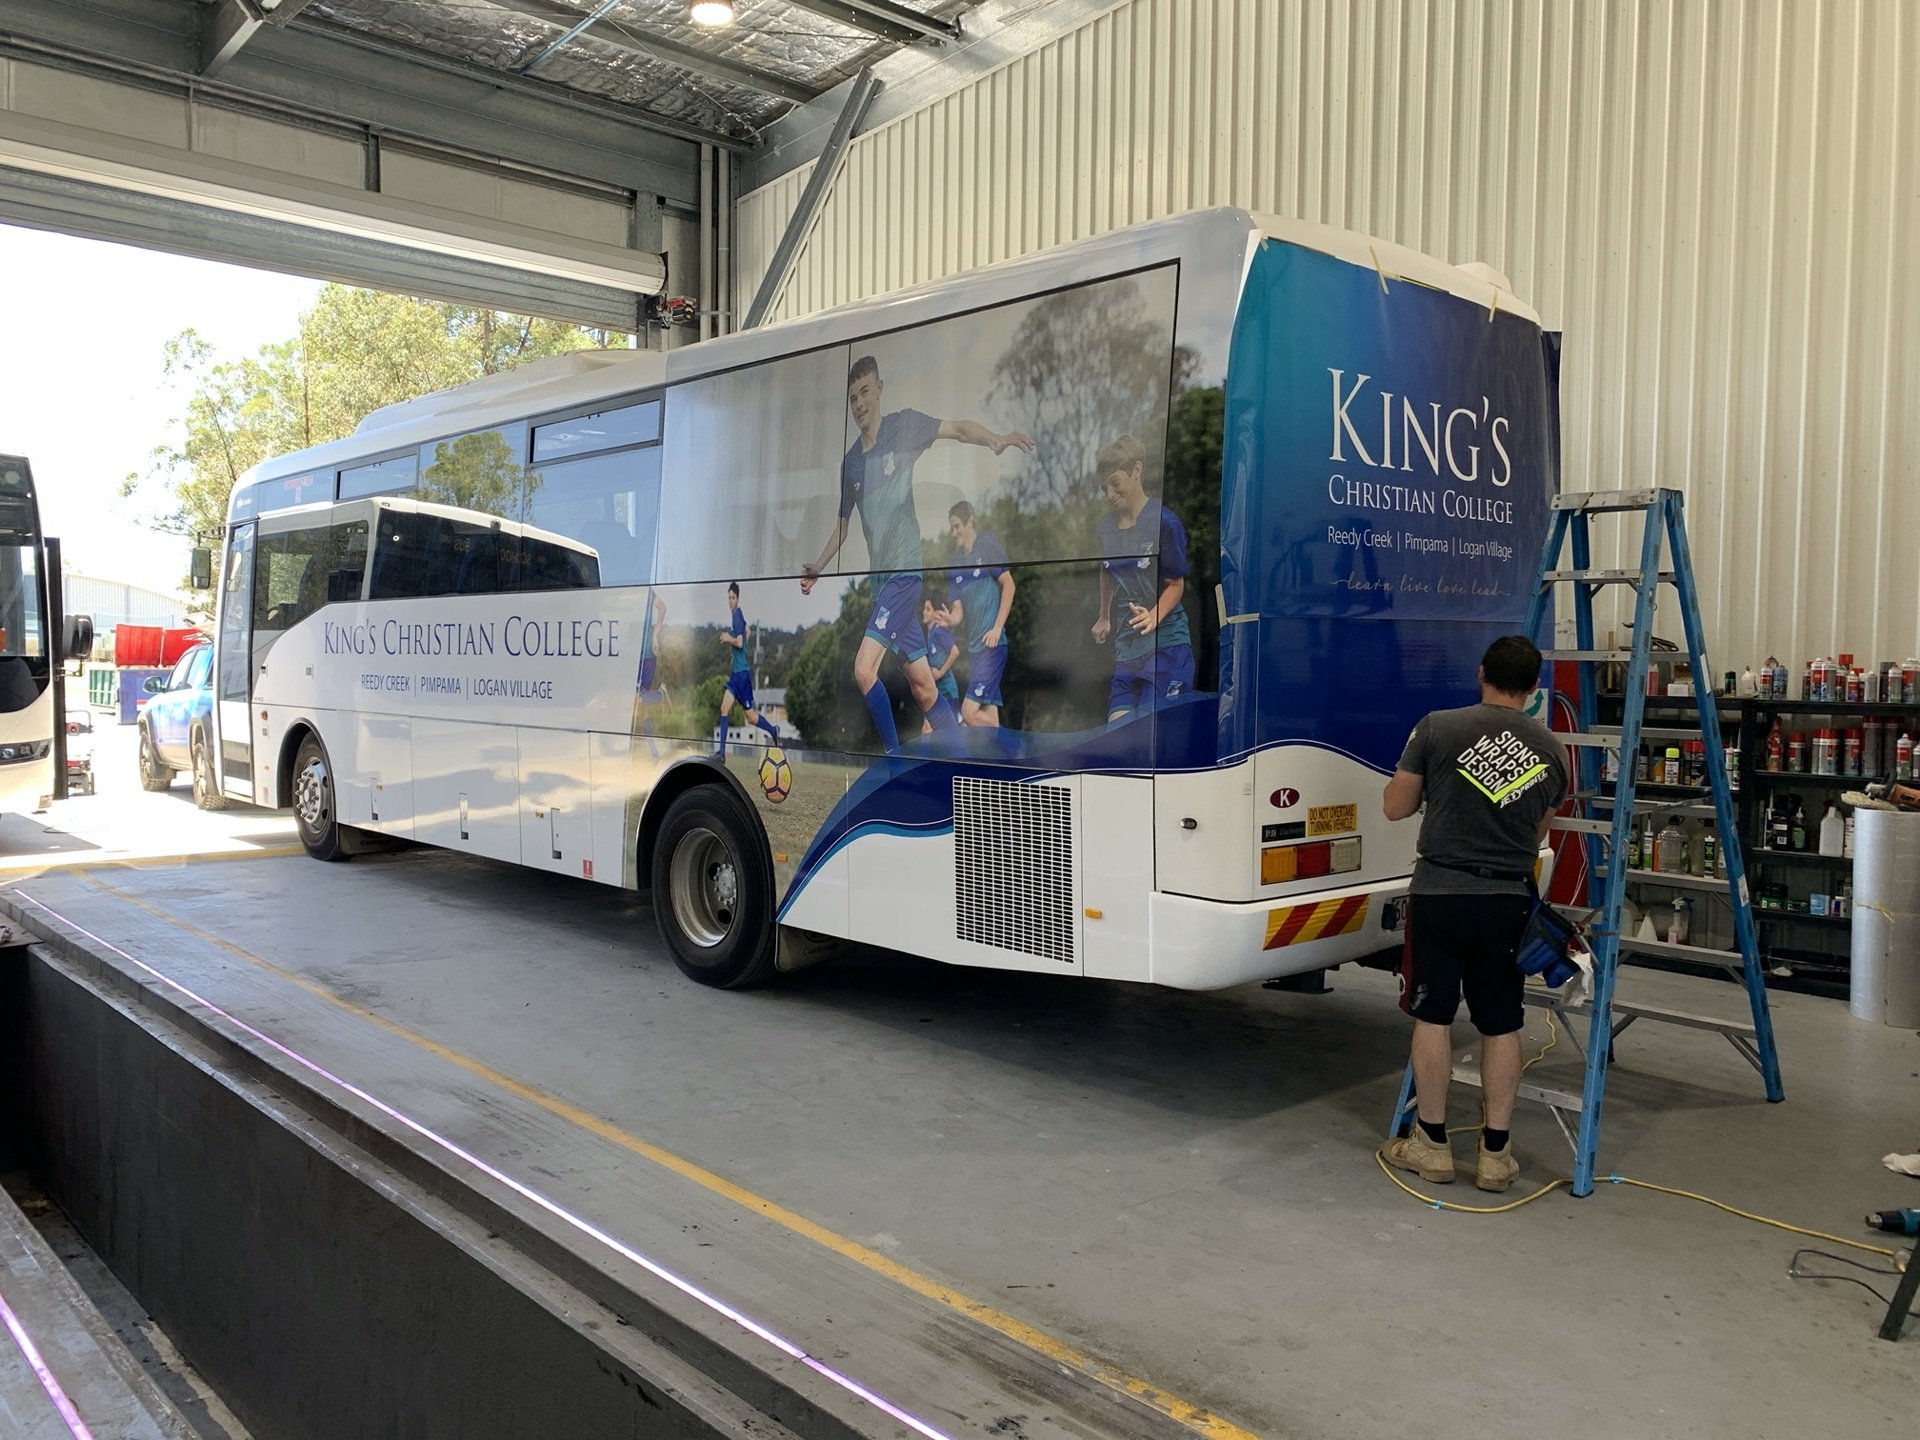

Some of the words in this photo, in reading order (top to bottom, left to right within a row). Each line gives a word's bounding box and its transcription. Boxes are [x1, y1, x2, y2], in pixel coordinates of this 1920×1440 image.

[1327, 368, 1511, 487] KING'S
[1328, 474, 1435, 515] CHRISTIAN
[1443, 489, 1513, 524] COLLEGE
[1328, 526, 1361, 550] Reedy
[1364, 529, 1393, 549] Creek
[1405, 532, 1449, 554] Pimpama
[1459, 538, 1485, 559] Logan
[1486, 541, 1512, 562] Village
[1330, 571, 1393, 592] learn
[1400, 573, 1431, 593] live
[1437, 576, 1466, 594] love
[1471, 579, 1509, 597] lead
[324, 619, 376, 655] KING'S
[382, 619, 495, 656] CHRISTIAN
[504, 615, 619, 657] COLLEGE
[361, 674, 384, 691] REEDY
[386, 675, 411, 692] CREEK
[421, 676, 461, 694] PIMPAMA
[473, 678, 508, 697] LOGAN
[509, 680, 553, 700] VILLAGE
[1457, 747, 1510, 793] DESIGN
[1474, 734, 1525, 782] WRAPS
[1494, 730, 1540, 770] SIGNS
[1280, 789, 1291, 807] K
